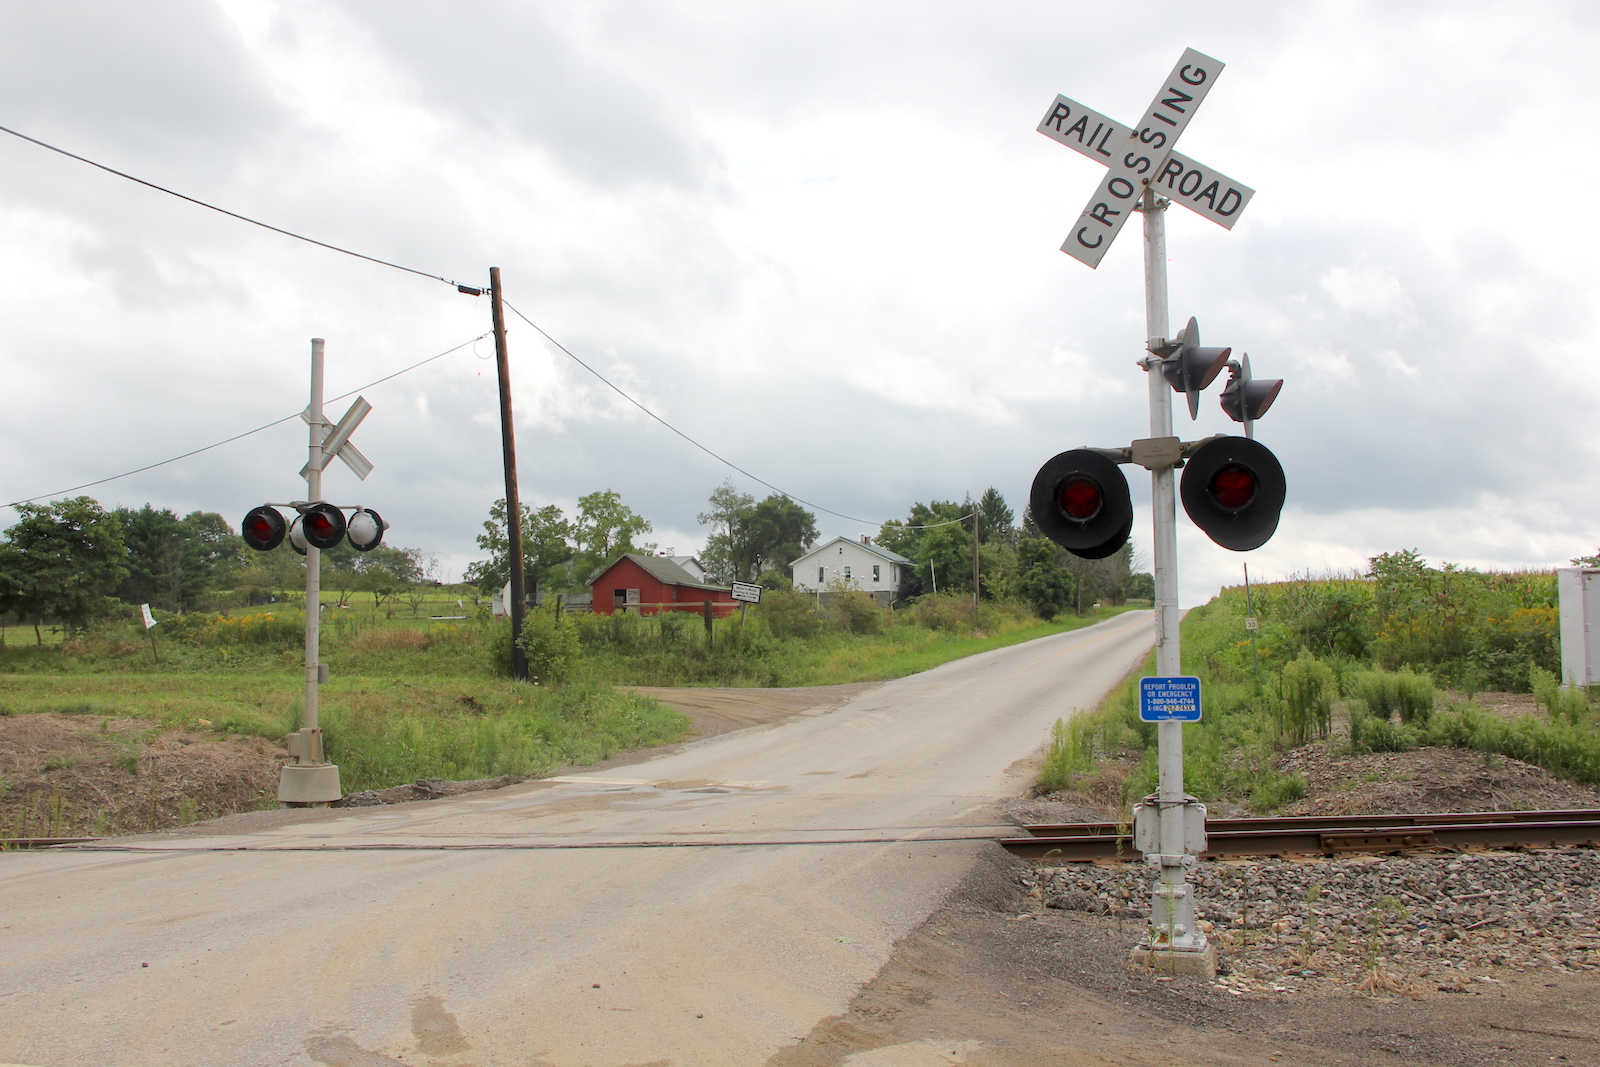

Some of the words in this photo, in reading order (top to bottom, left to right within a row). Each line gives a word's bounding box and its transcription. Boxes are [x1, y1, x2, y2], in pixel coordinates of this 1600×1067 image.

[1045, 102, 1114, 158] RAIL
[1076, 64, 1208, 249] CROSSING
[1156, 158, 1243, 217] ROAD
